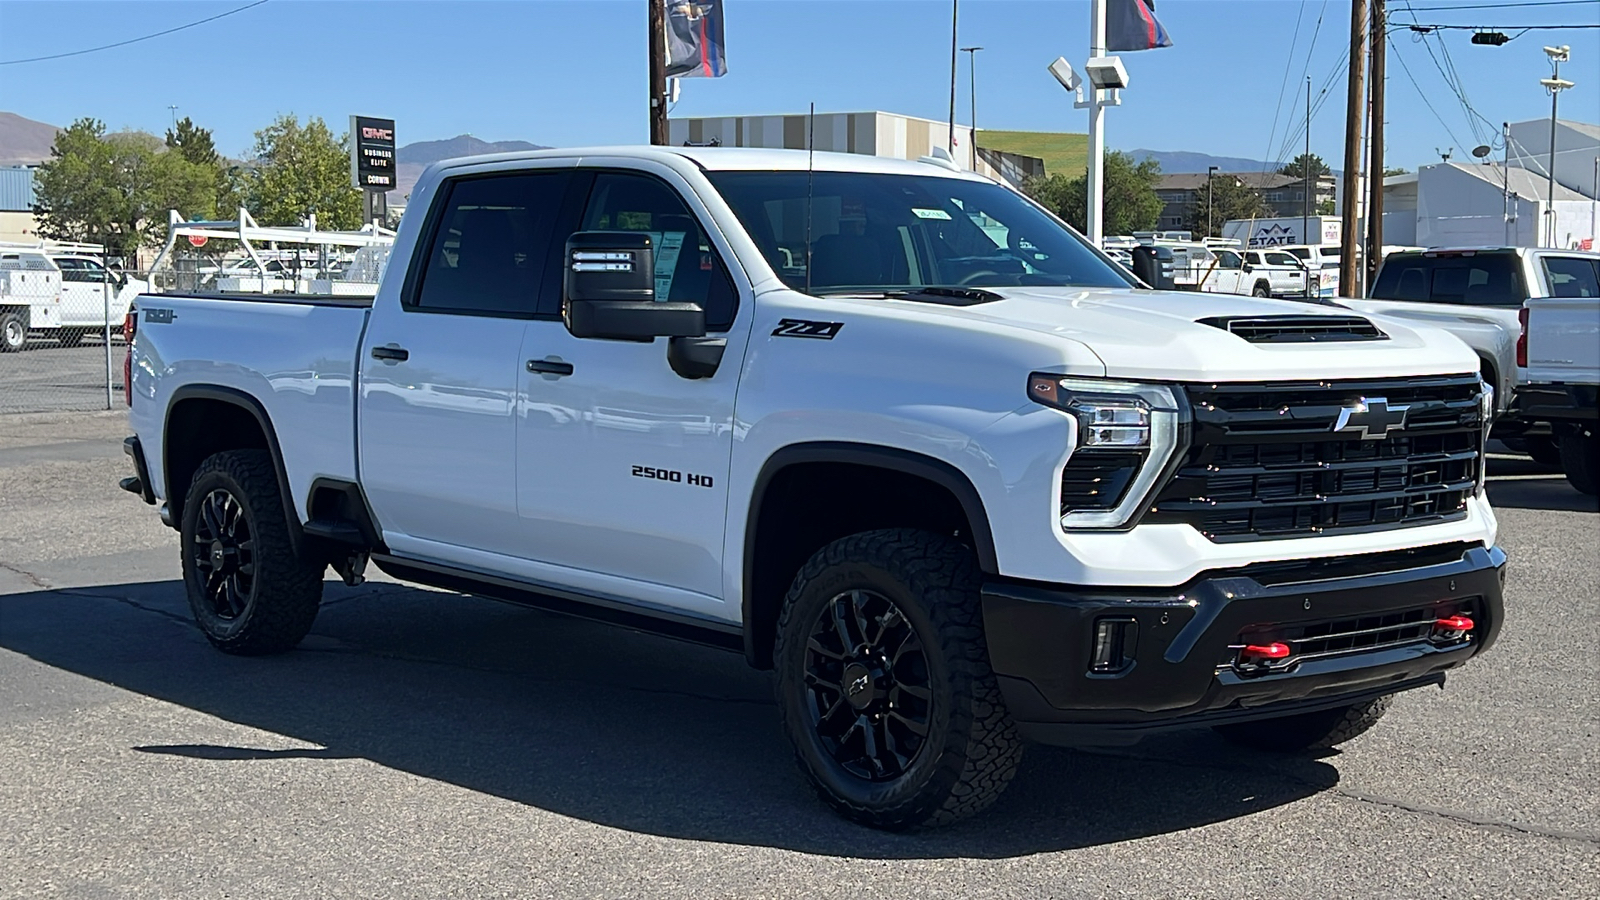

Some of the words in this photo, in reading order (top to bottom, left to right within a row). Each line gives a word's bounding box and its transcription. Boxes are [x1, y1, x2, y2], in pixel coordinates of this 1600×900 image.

[362, 127, 393, 140] GMC
[364, 148, 392, 158] BUSINESS
[370, 158, 387, 167] ELITE
[1248, 236, 1296, 246] STATE
[770, 318, 845, 341] Z71
[632, 465, 682, 483] 2500
[687, 473, 714, 488] HD
